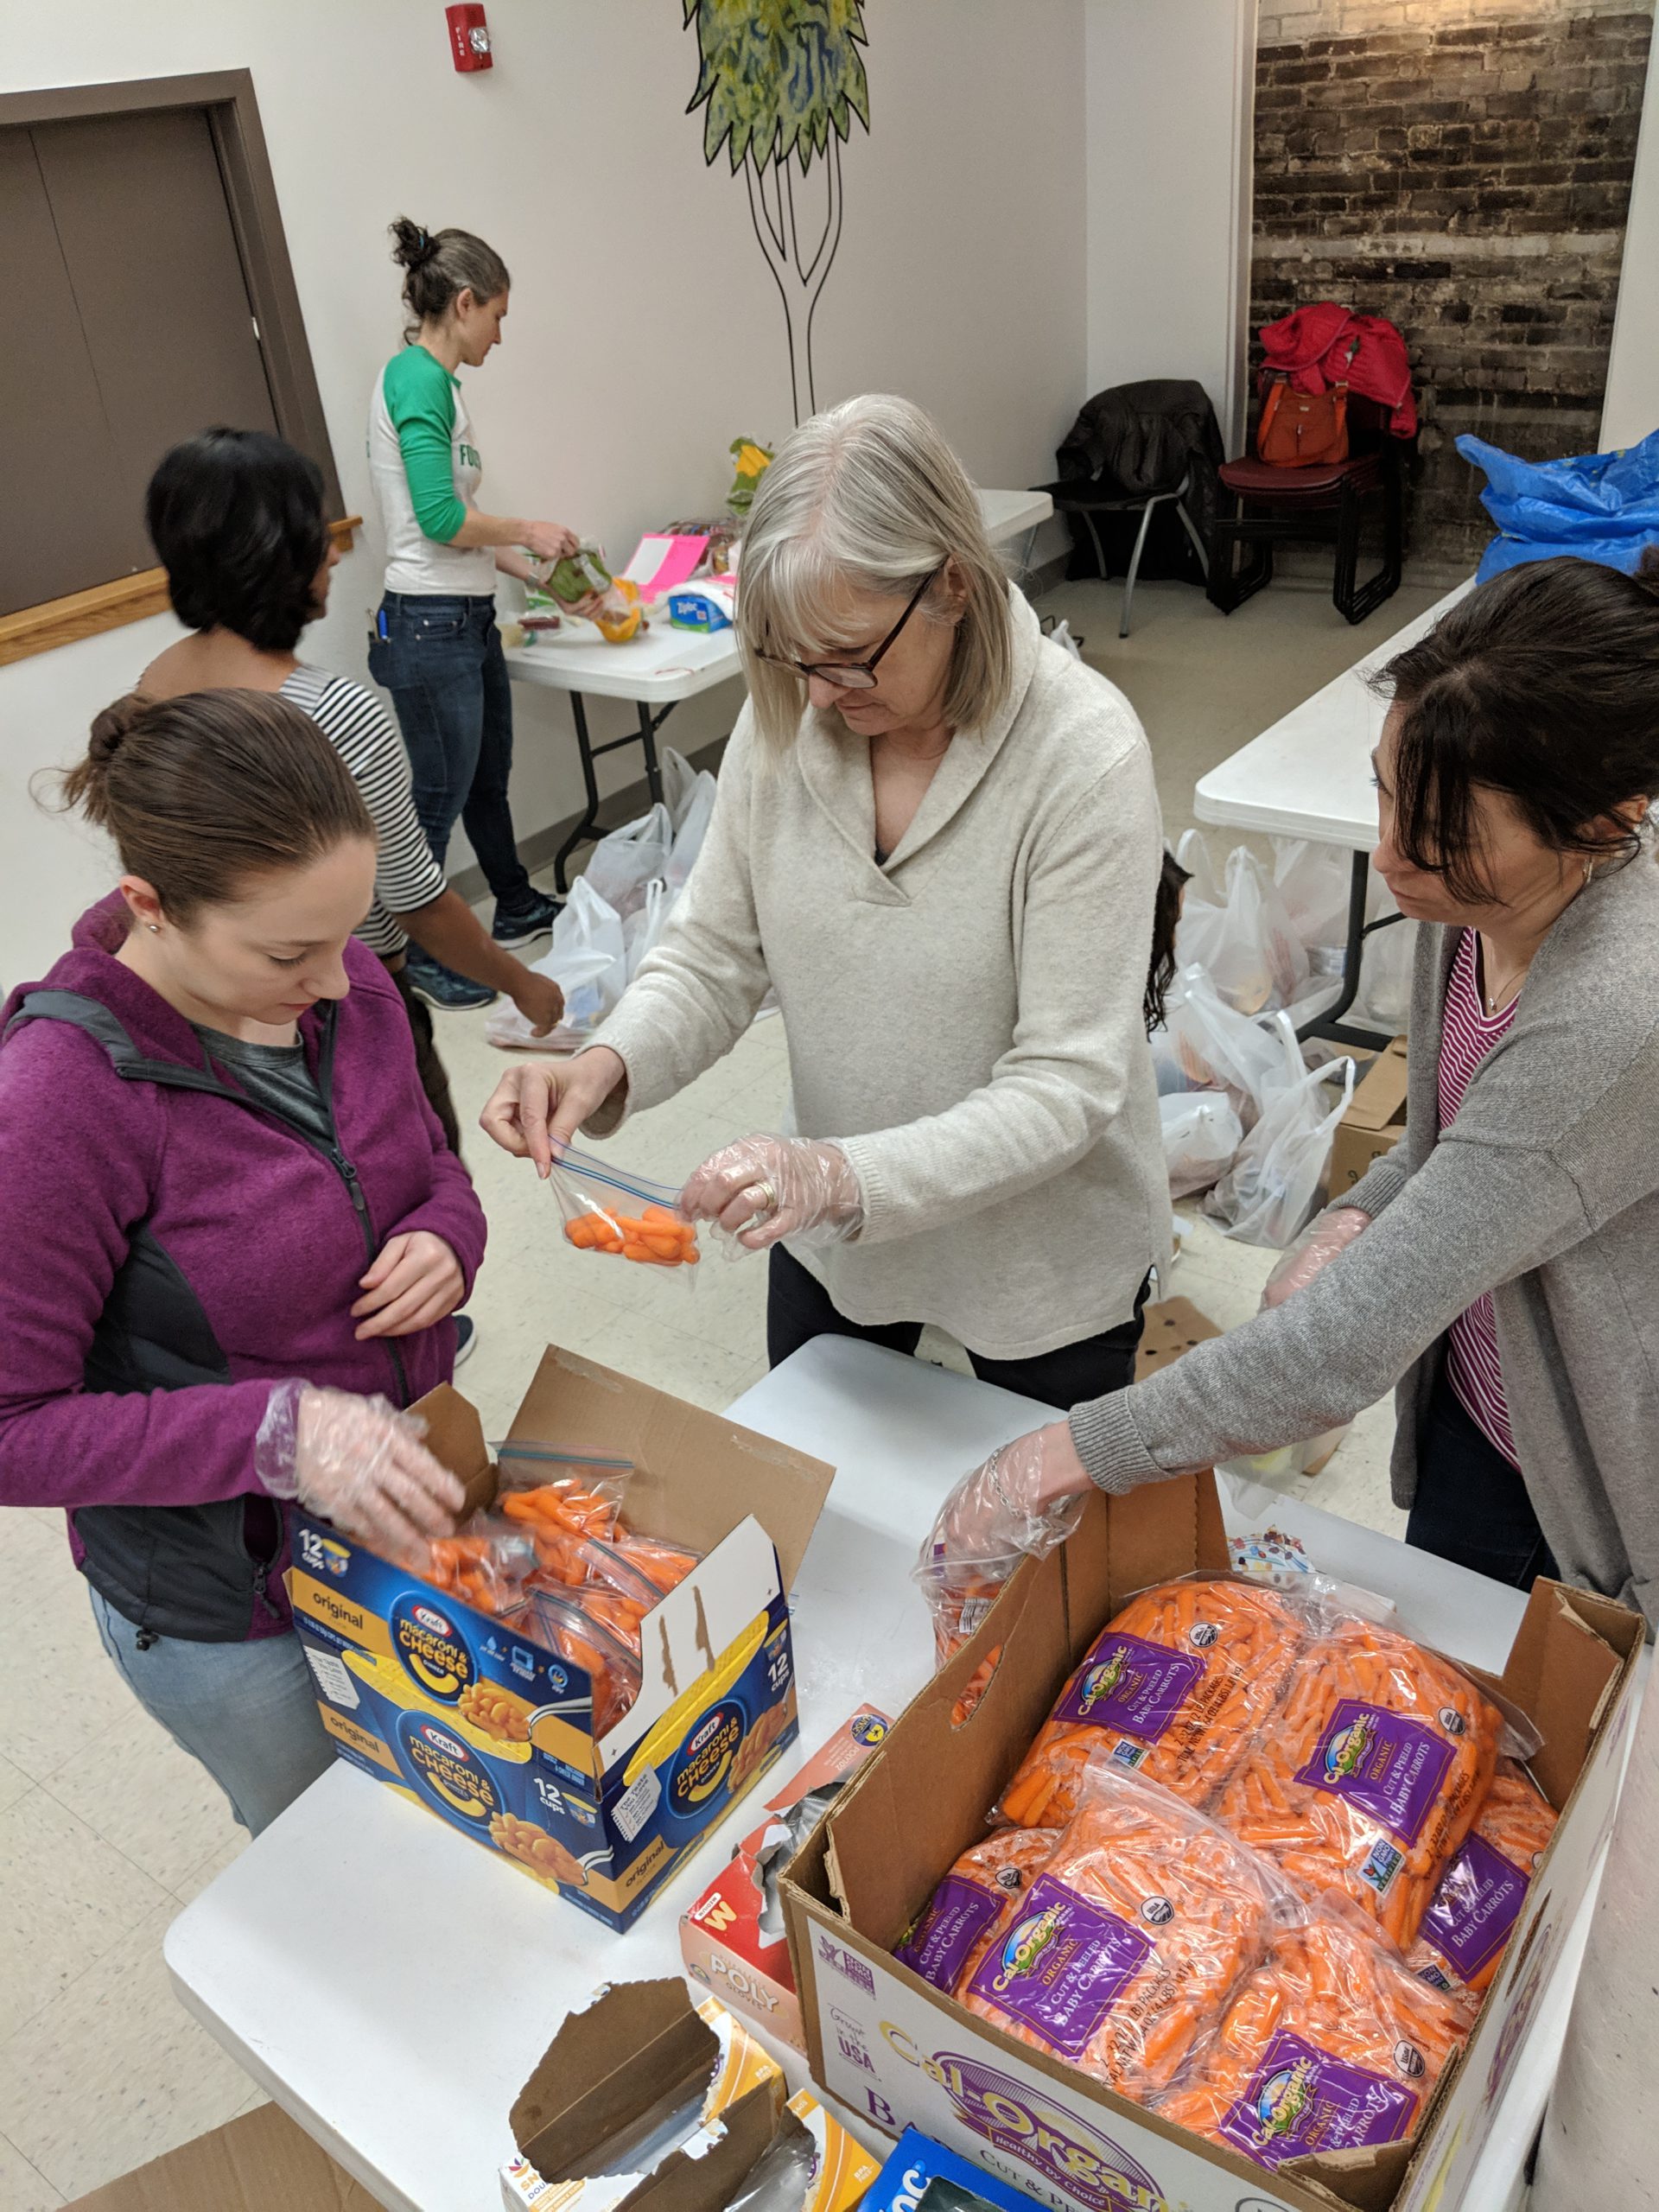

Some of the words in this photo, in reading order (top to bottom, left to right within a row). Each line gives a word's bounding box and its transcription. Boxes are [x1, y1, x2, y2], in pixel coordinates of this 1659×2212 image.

[298, 1529, 322, 1559] 12
[314, 1592, 363, 1630] original
[400, 1618, 458, 1658] macaroni
[768, 1652, 788, 1682] 12
[771, 1671, 790, 1692] cups
[1142, 1669, 1163, 1696] PEELED
[1132, 1704, 1153, 1724] BABY
[1148, 1662, 1180, 1705] CARROTS
[330, 1717, 379, 1753] original
[429, 1731, 459, 1756] Kraft
[695, 1721, 716, 1747] Kraft
[1324, 1713, 1370, 1784] Cl-Organic
[410, 1735, 479, 1784] macaroni
[677, 1725, 729, 1784] macaroni
[1370, 1740, 1393, 1780] ORGANIC
[1395, 1742, 1413, 1770] PEELED
[1382, 1777, 1398, 1796] CUT
[1389, 1783, 1412, 1815] BABY
[1403, 1741, 1431, 1785] CARROTS
[1390, 1770, 1402, 1779] &
[533, 1777, 563, 1806] 12
[539, 1796, 566, 1815] cups
[626, 1840, 664, 1887] original
[1372, 1838, 1386, 1857] NON
[1377, 1845, 1390, 1864] GMO
[698, 1896, 718, 1916] MEDIUM
[935, 1906, 961, 1935] PEELED
[1452, 1922, 1478, 1948] BABY
[1472, 1879, 1515, 1923] CARROTS
[918, 1943, 934, 1965] CUT
[925, 1948, 947, 1980] BABY
[941, 1902, 980, 1948] CARROTS
[931, 1935, 941, 1943] &
[992, 1902, 1066, 1991] Cal-Organic
[1041, 1939, 1078, 1986] ORGANIC
[1050, 1983, 1071, 2005] CUT
[1065, 1974, 1078, 1983] &
[1073, 1940, 1101, 1973] PEELED
[710, 1954, 779, 2012] POLY
[726, 1981, 762, 2011] GLOVES
[830, 2007, 866, 2037] Grown
[1056, 1991, 1084, 2026] BABY
[838, 2035, 875, 2074] USA
[849, 2033, 868, 2053] the
[880, 2020, 1192, 2212] Cal-Organ
[1251, 2056, 1313, 2146] Cal-Organic
[1304, 2101, 1338, 2146] ORGANIC
[520, 2172, 540, 2192] SN
[854, 2164, 868, 2178] BPA
[980, 2149, 1023, 2181] CUT
[1025, 2179, 1044, 2196] &
[995, 2135, 1042, 2167] Healthy
[1045, 2165, 1062, 2181] by
[1064, 2180, 1106, 2207] choice
[527, 2182, 550, 2200] DOU
